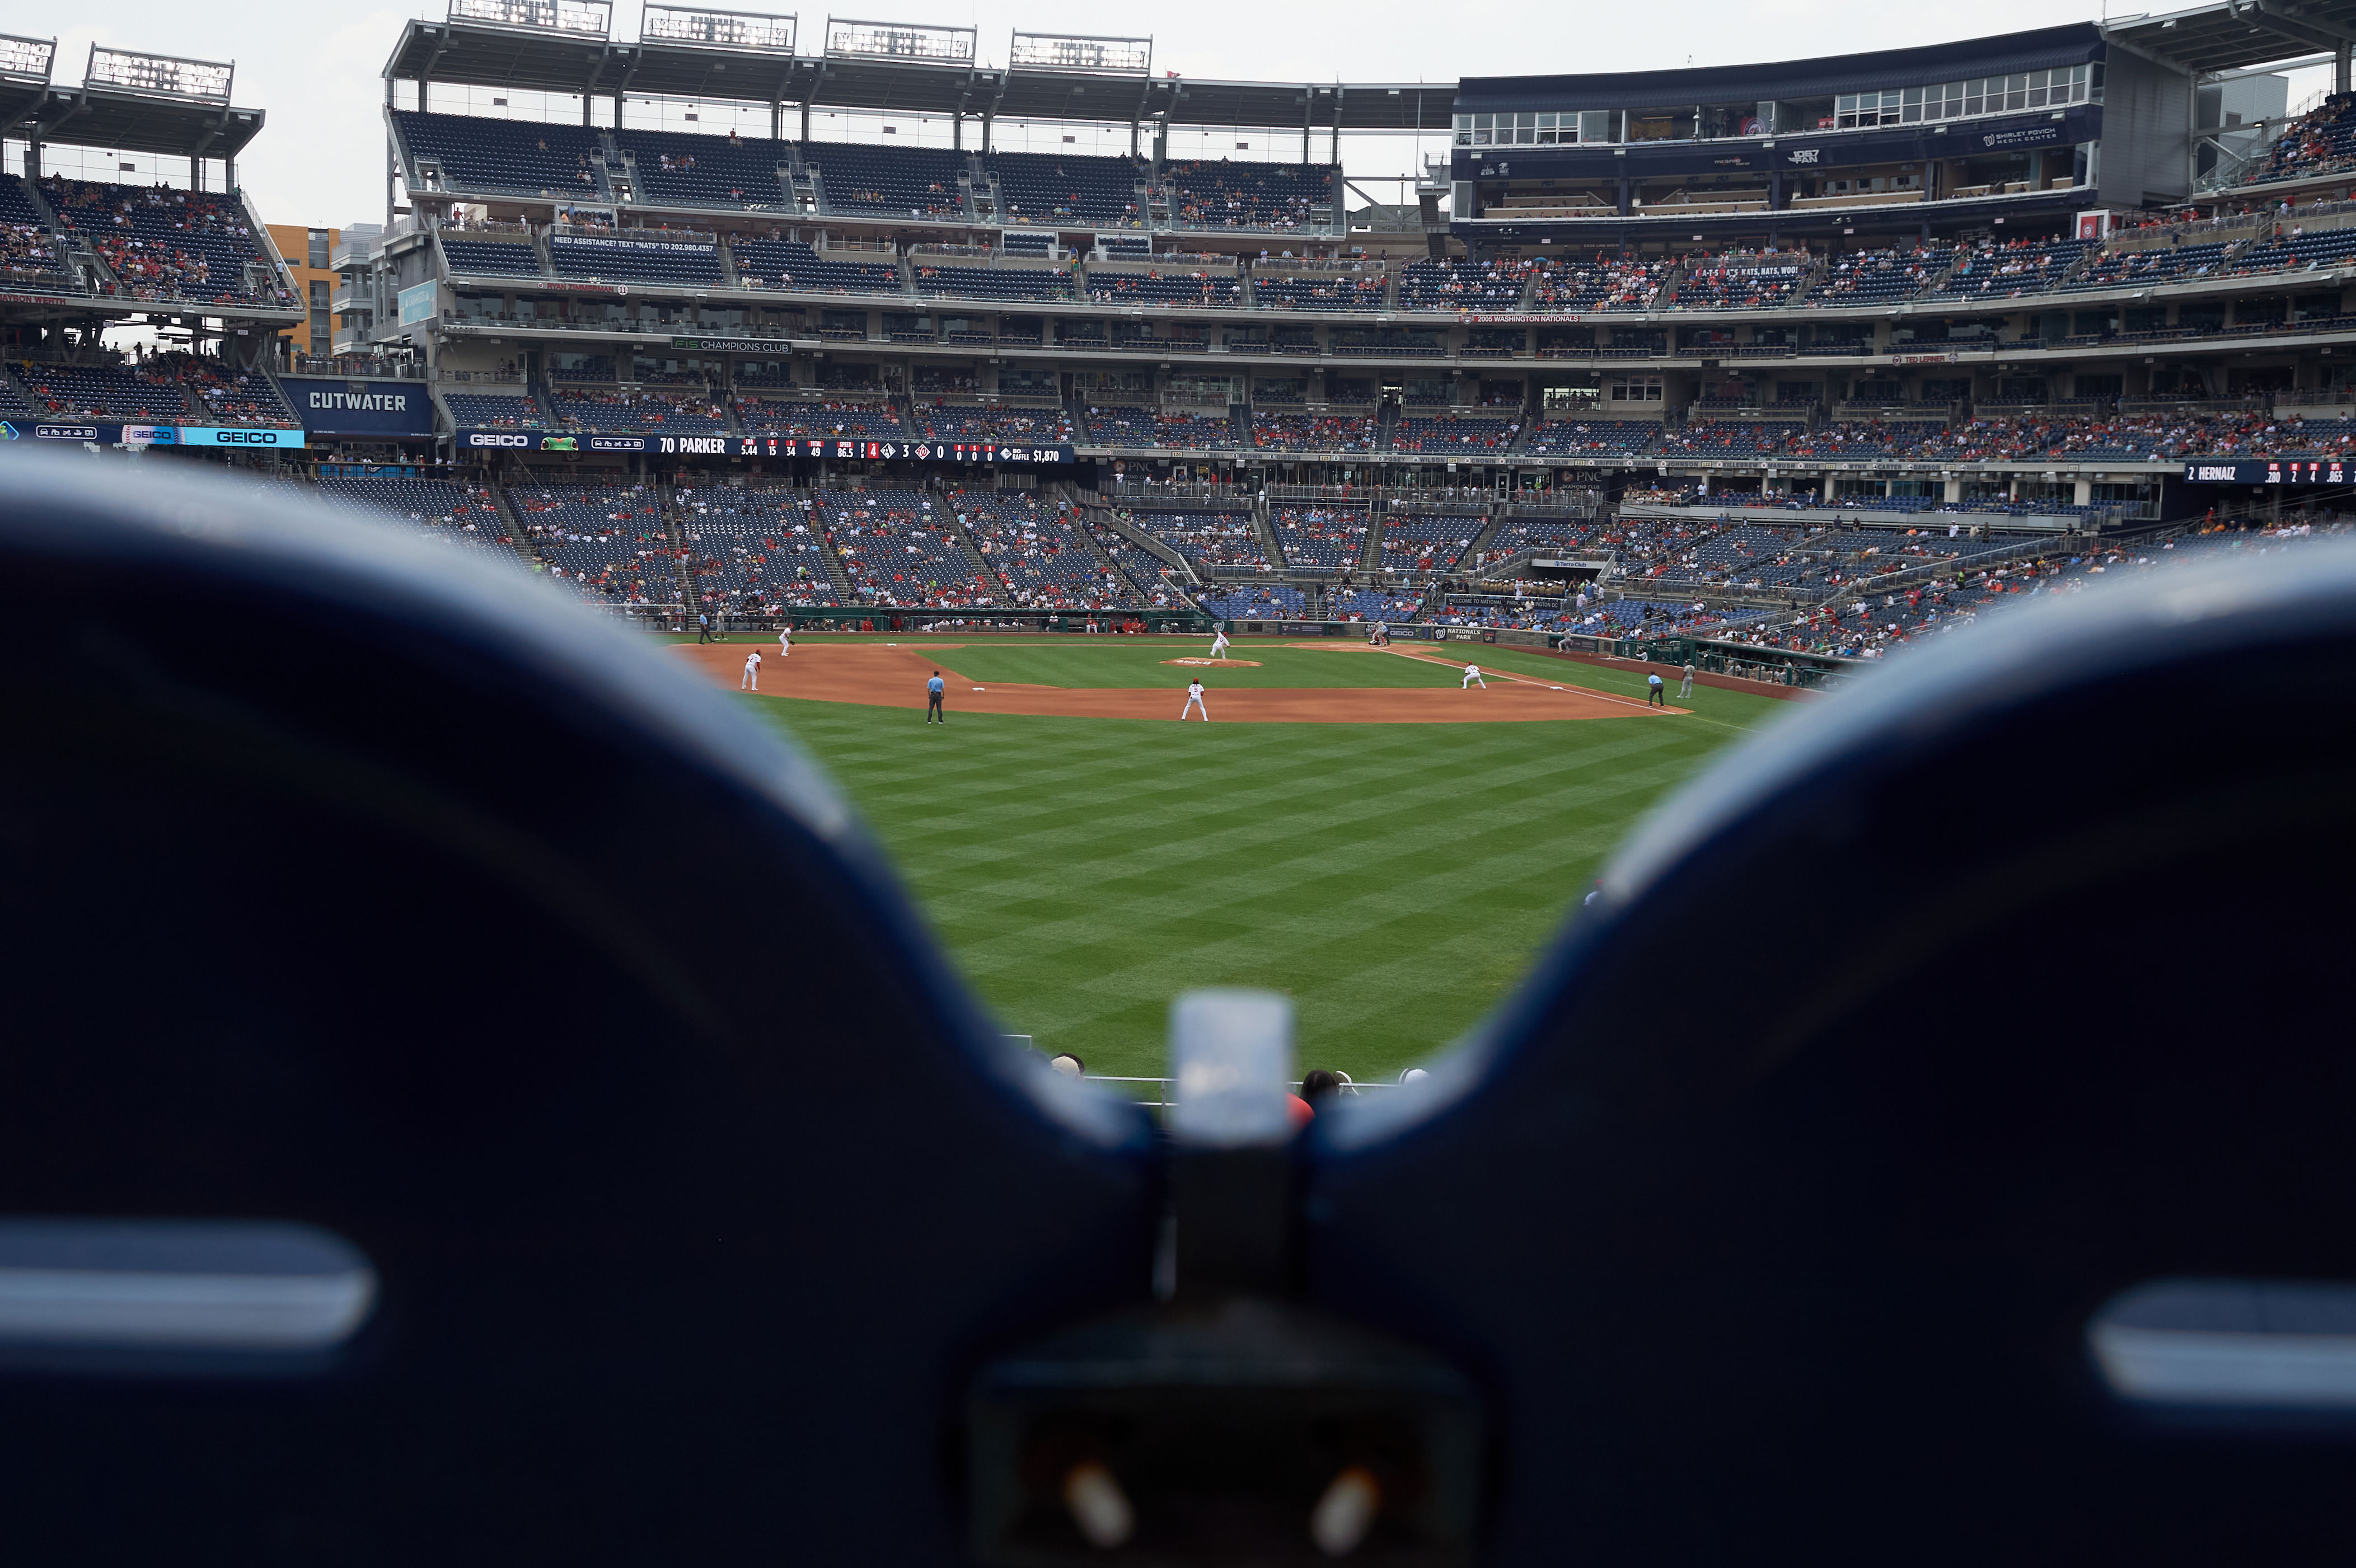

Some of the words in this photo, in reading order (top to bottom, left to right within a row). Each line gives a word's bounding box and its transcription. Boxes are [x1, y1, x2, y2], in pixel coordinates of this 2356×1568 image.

[574, 238, 616, 247] ASSISTANCE?
[35, 297, 66, 305] WERTH
[701, 341, 760, 351] CHAMPIONS
[762, 344, 789, 352] CLUB
[310, 392, 406, 411] CUTWATER
[133, 431, 171, 439] GEICO
[217, 431, 277, 444] GEICO
[470, 434, 528, 447] GEICO
[660, 438, 675, 453] 70
[680, 438, 725, 454] PARKER
[741, 445, 758, 456] 5.44
[769, 446, 776, 456] 15
[786, 446, 796, 456] 34
[902, 444, 909, 458] 3
[811, 447, 821, 457] 49
[837, 448, 854, 458] 86.5
[937, 445, 944, 459] 0
[957, 451, 962, 461] 0
[972, 452, 977, 461] 0
[987, 452, 992, 462] 0
[1033, 449, 1059, 463] $1,870
[1128, 461, 1154, 472] PNC
[1577, 471, 1602, 482] PNC
[2188, 466, 2194, 480] 2
[2199, 466, 2236, 480] HERNAIZ
[2265, 471, 2281, 483] .280
[2292, 471, 2297, 482] 2
[2310, 471, 2316, 482] 4
[2327, 471, 2343, 482] .865
